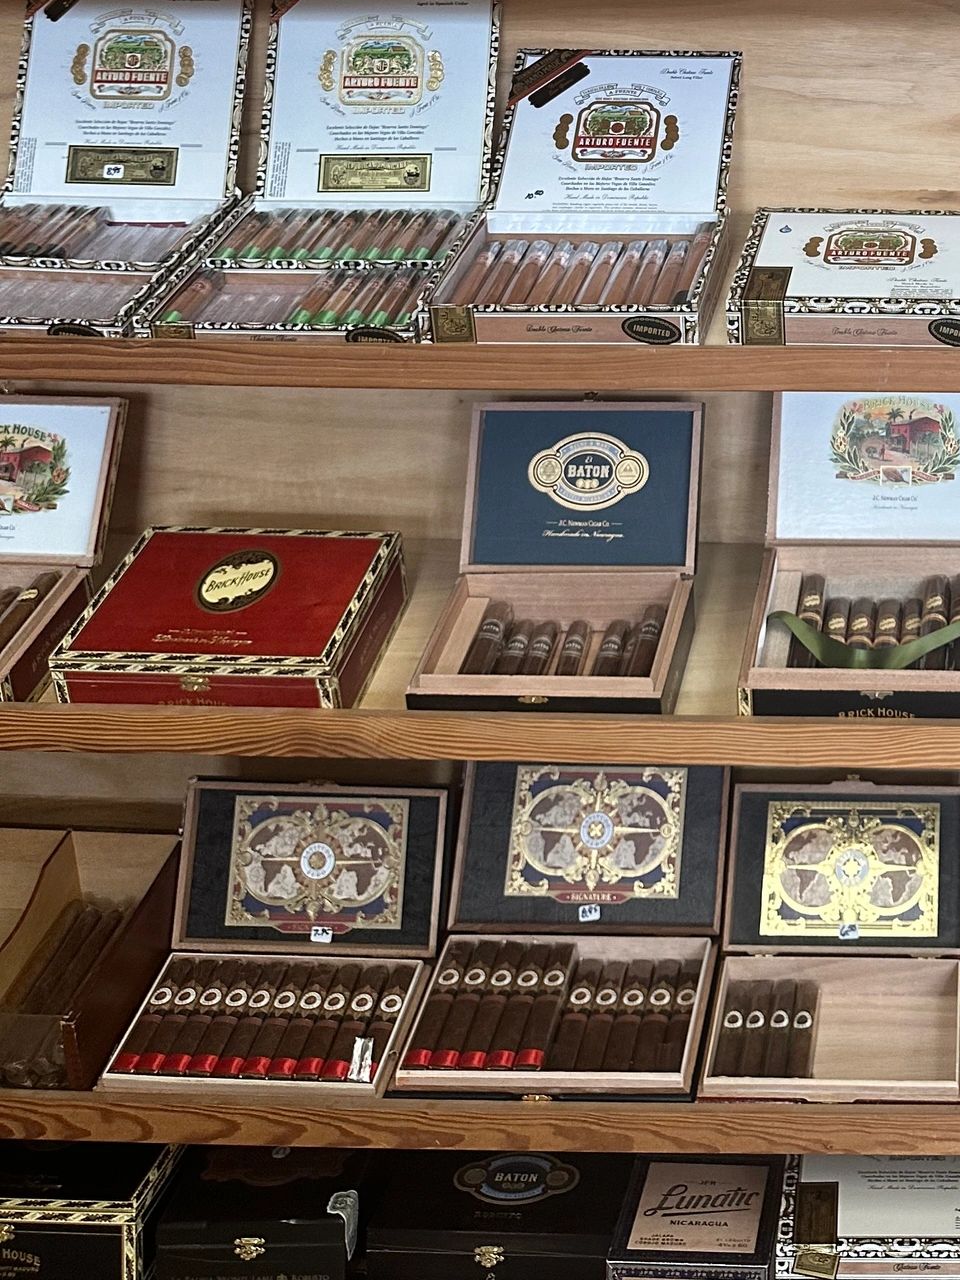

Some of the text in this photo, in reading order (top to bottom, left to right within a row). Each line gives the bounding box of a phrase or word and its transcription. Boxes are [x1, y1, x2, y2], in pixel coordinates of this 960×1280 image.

[96, 72, 168, 82] ARTURO FUENTE
[344, 78, 417, 87] ARTURO FUENTE
[579, 138, 651, 147] ARTURO FUENTE
[633, 324, 672, 338] IMPORTED
[12, 424, 47, 441] HOUSE
[568, 464, 611, 478] BATON
[205, 568, 271, 593] BRICK HOUSE
[494, 1172, 539, 1183] BATON
[644, 1184, 760, 1216] Lunatic
[669, 1219, 728, 1227] NICARAGUA
[2, 1248, 41, 1267] HOUSE
